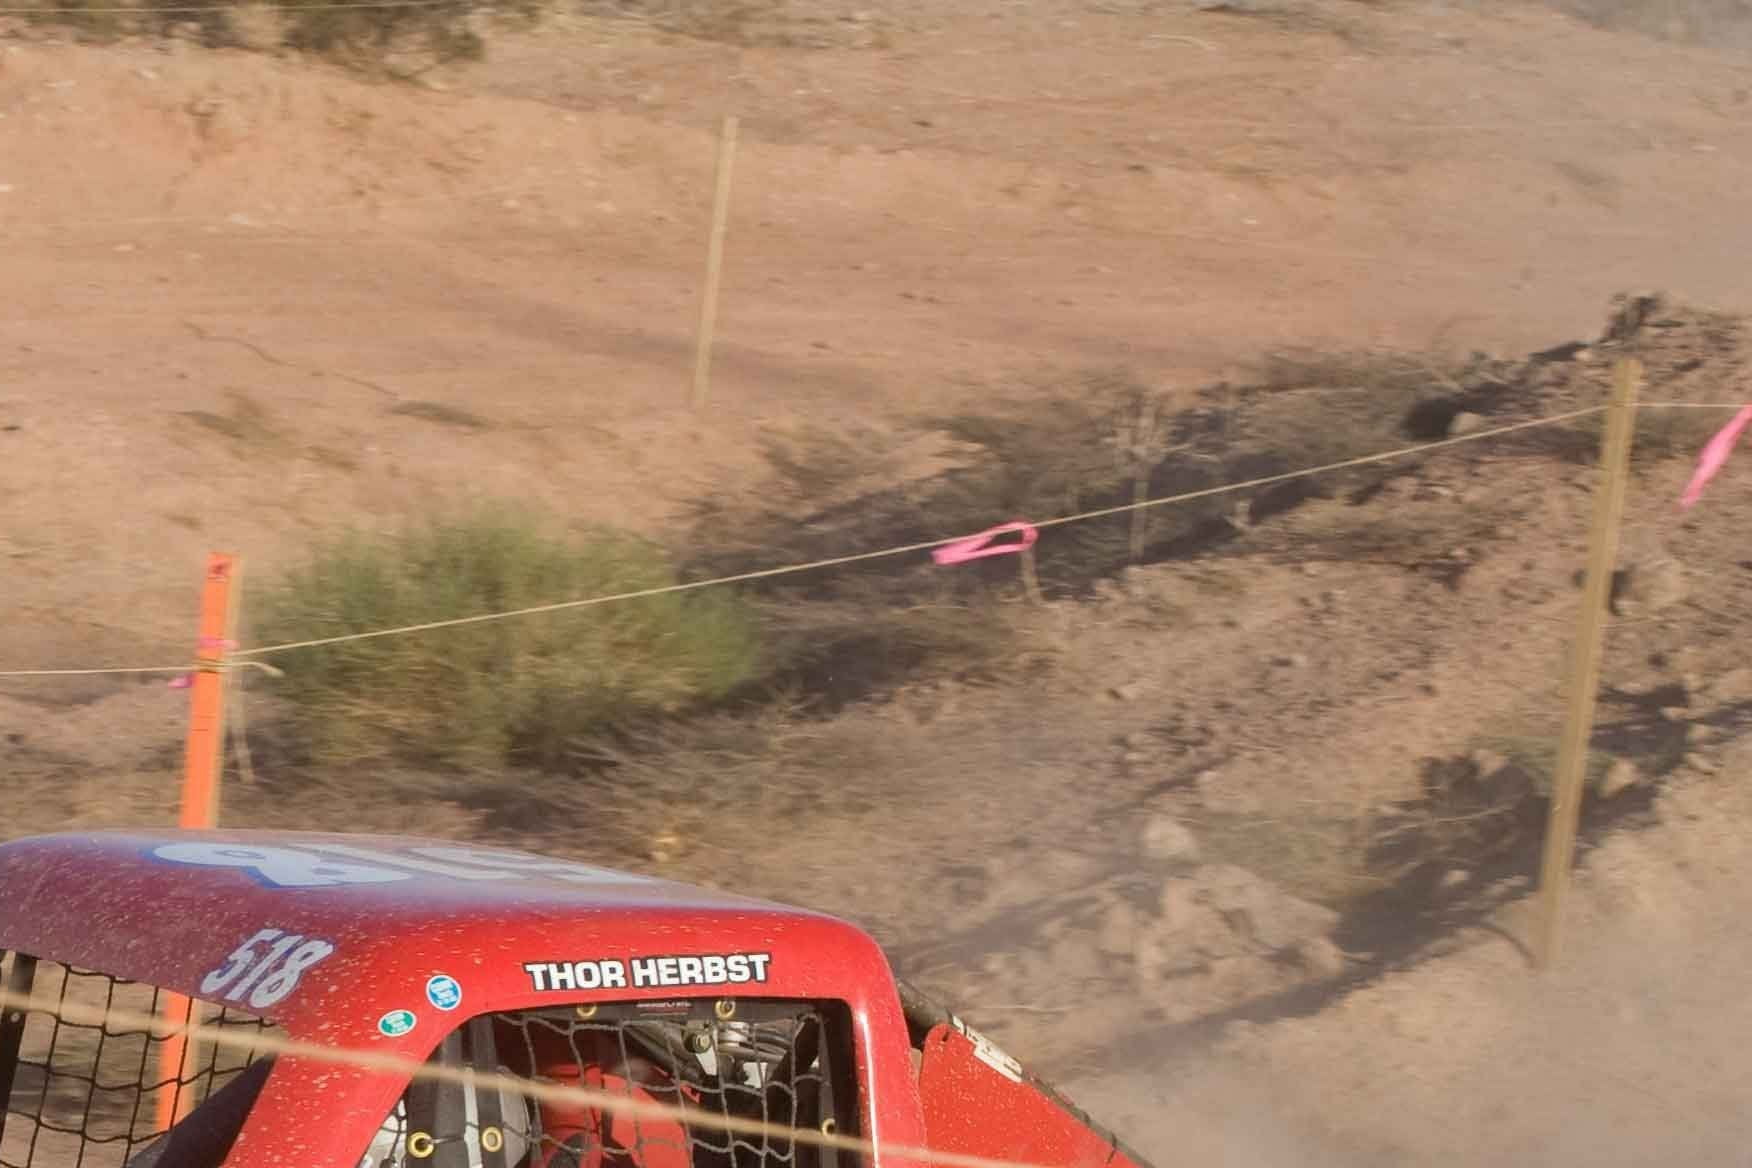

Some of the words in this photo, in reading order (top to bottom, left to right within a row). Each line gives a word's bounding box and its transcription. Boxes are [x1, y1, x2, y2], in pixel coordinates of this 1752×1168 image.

[199, 928, 334, 1008] 518
[525, 961, 628, 991] THOR
[630, 953, 770, 987] HERBST
